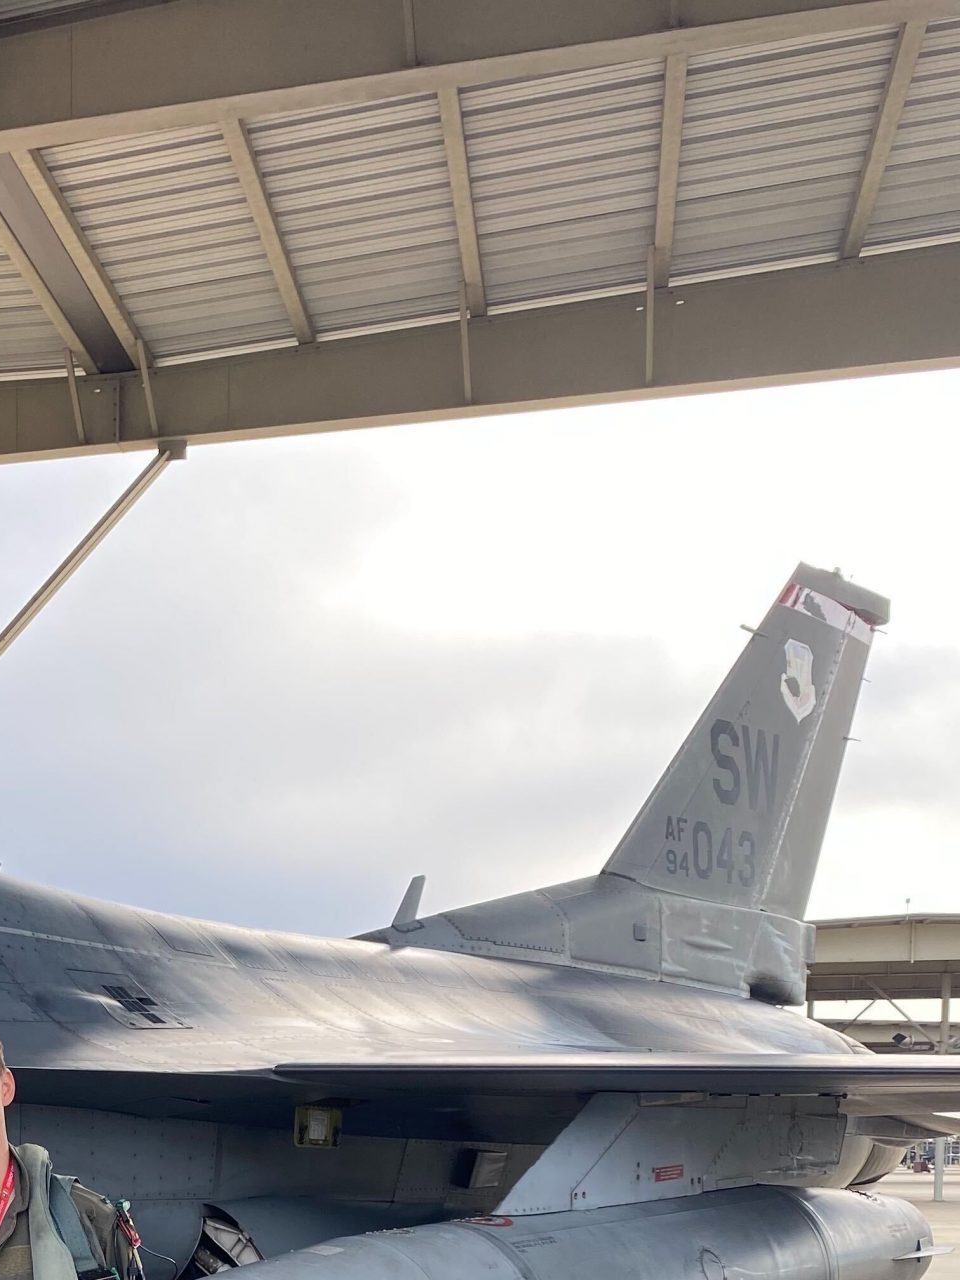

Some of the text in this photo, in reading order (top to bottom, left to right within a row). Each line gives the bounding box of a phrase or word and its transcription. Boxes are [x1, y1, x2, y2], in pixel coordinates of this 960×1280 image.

[710, 718, 780, 812] SW
[665, 815, 688, 842] AF
[665, 849, 690, 878] 94
[692, 820, 756, 888] 043
